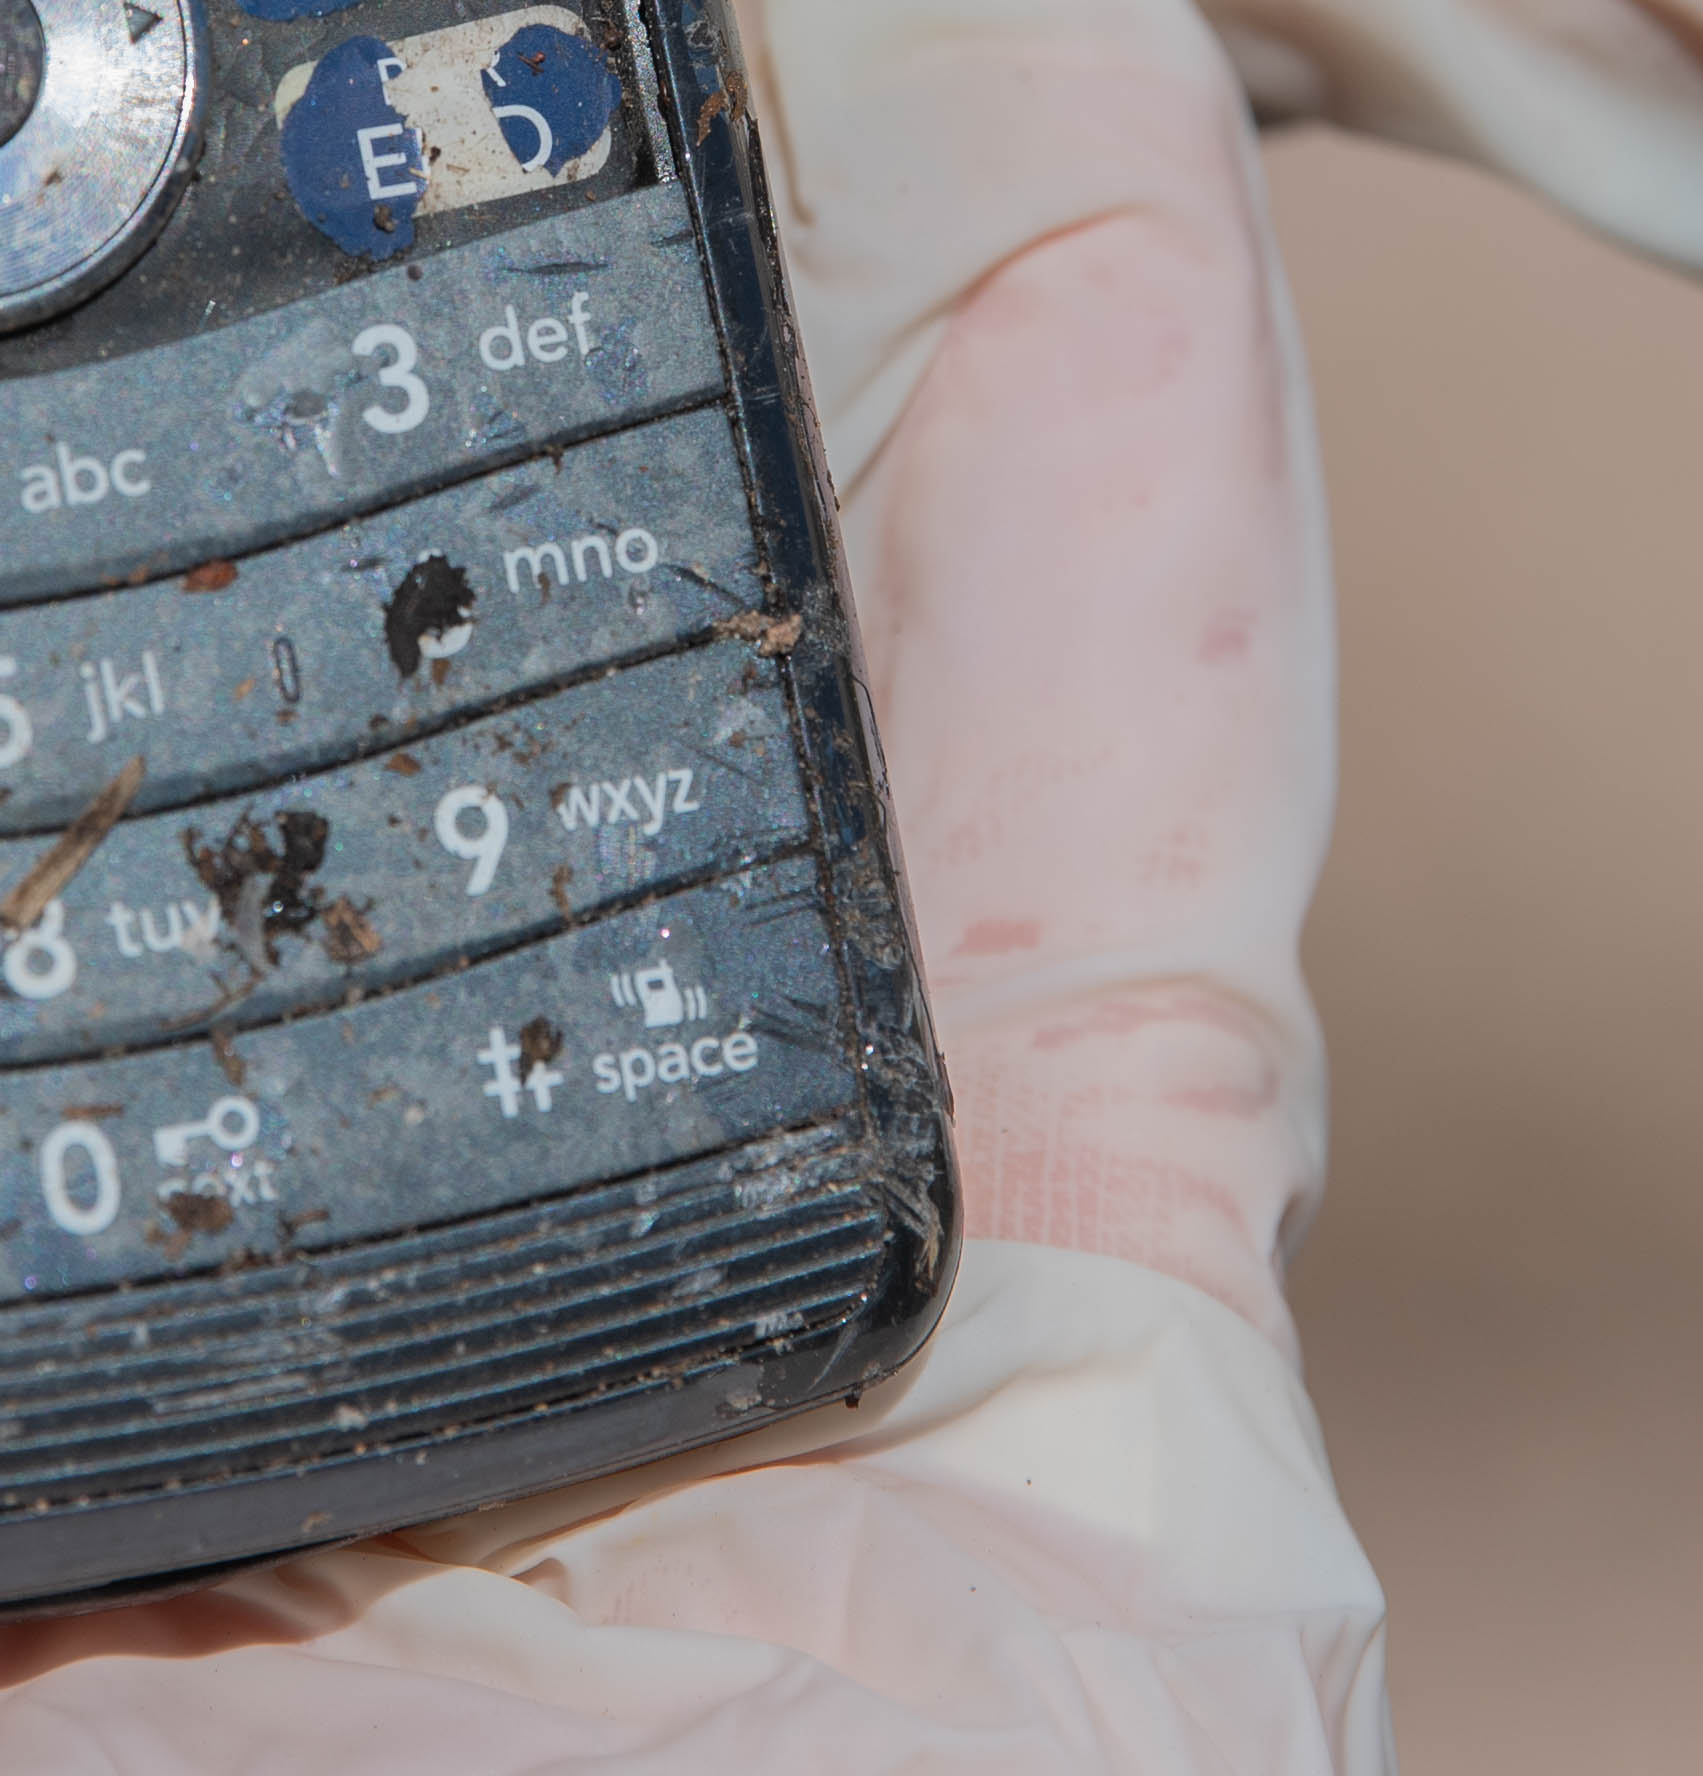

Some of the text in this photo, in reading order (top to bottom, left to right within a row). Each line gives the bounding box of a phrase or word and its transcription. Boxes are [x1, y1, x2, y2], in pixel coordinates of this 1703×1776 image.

[357, 103, 553, 200] ED
[350, 290, 592, 434] 3 def
[19, 441, 151, 514] abc
[502, 527, 659, 594] mno
[79, 650, 165, 744] jkl
[434, 767, 700, 897] 9 wxyz
[592, 1031, 760, 1103] space
[40, 1119, 121, 1236] 0
